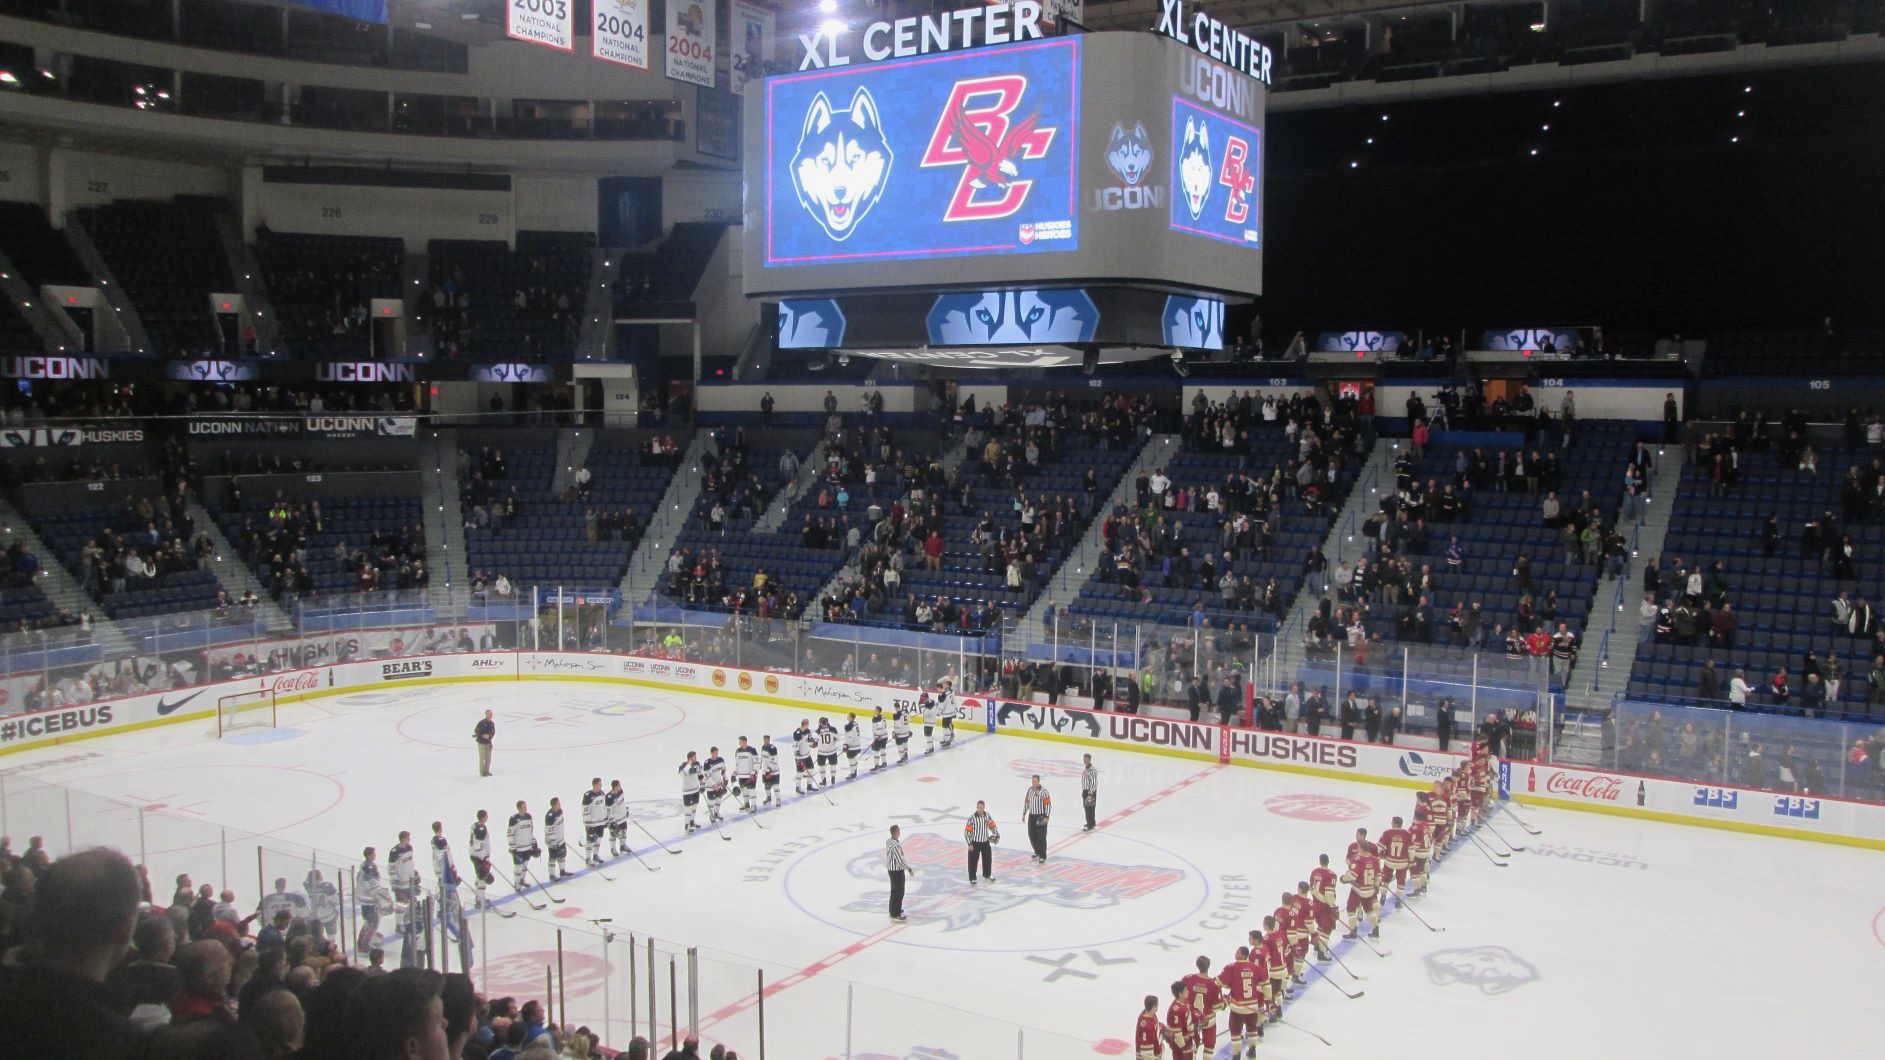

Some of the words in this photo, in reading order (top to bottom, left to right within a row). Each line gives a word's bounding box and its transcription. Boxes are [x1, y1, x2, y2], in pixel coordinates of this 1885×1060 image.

[519, 14, 561, 32] NATIONAL
[597, 12, 644, 42] 2004
[516, 26, 565, 45] CHAMPIONS
[798, 32, 850, 71] XL
[862, 0, 1043, 61] CENTER
[1159, 0, 1189, 44] XL
[1194, 12, 1272, 85] CENTER
[602, 37, 640, 53] NATIONAL
[669, 35, 712, 62] 2004
[600, 48, 643, 65] CHAMPIONS
[674, 58, 708, 73] NATIONAL
[670, 69, 711, 84] CHAMPIONS
[1179, 50, 1256, 116] UCONN
[0, 356, 110, 379] UCONN
[316, 362, 415, 382] UCONN
[1269, 378, 1287, 386] 103
[1543, 378, 1564, 387] 104
[1810, 380, 1830, 389] 105
[189, 422, 242, 434] UCONN
[306, 417, 375, 431] UCONN
[81, 430, 144, 443] HUSKIES
[271, 639, 359, 667] HUSKS
[382, 661, 433, 674] BEAR'S
[623, 661, 645, 669] UCONN
[650, 663, 671, 672] UCONN
[675, 666, 696, 675] UCONN
[854, 691, 873, 702] Sun
[0, 705, 113, 740] #ICEBUS
[820, 733, 831, 745] 10
[1110, 716, 1212, 750] UCONN
[1232, 732, 1357, 768] HUSKIES
[1546, 771, 1623, 801] Coca-Cola
[744, 835, 824, 882] CENTER
[1146, 934, 1203, 951] XL
[1199, 873, 1253, 930] CENTER
[1024, 950, 1139, 983] XL
[1242, 978, 1253, 998] 5
